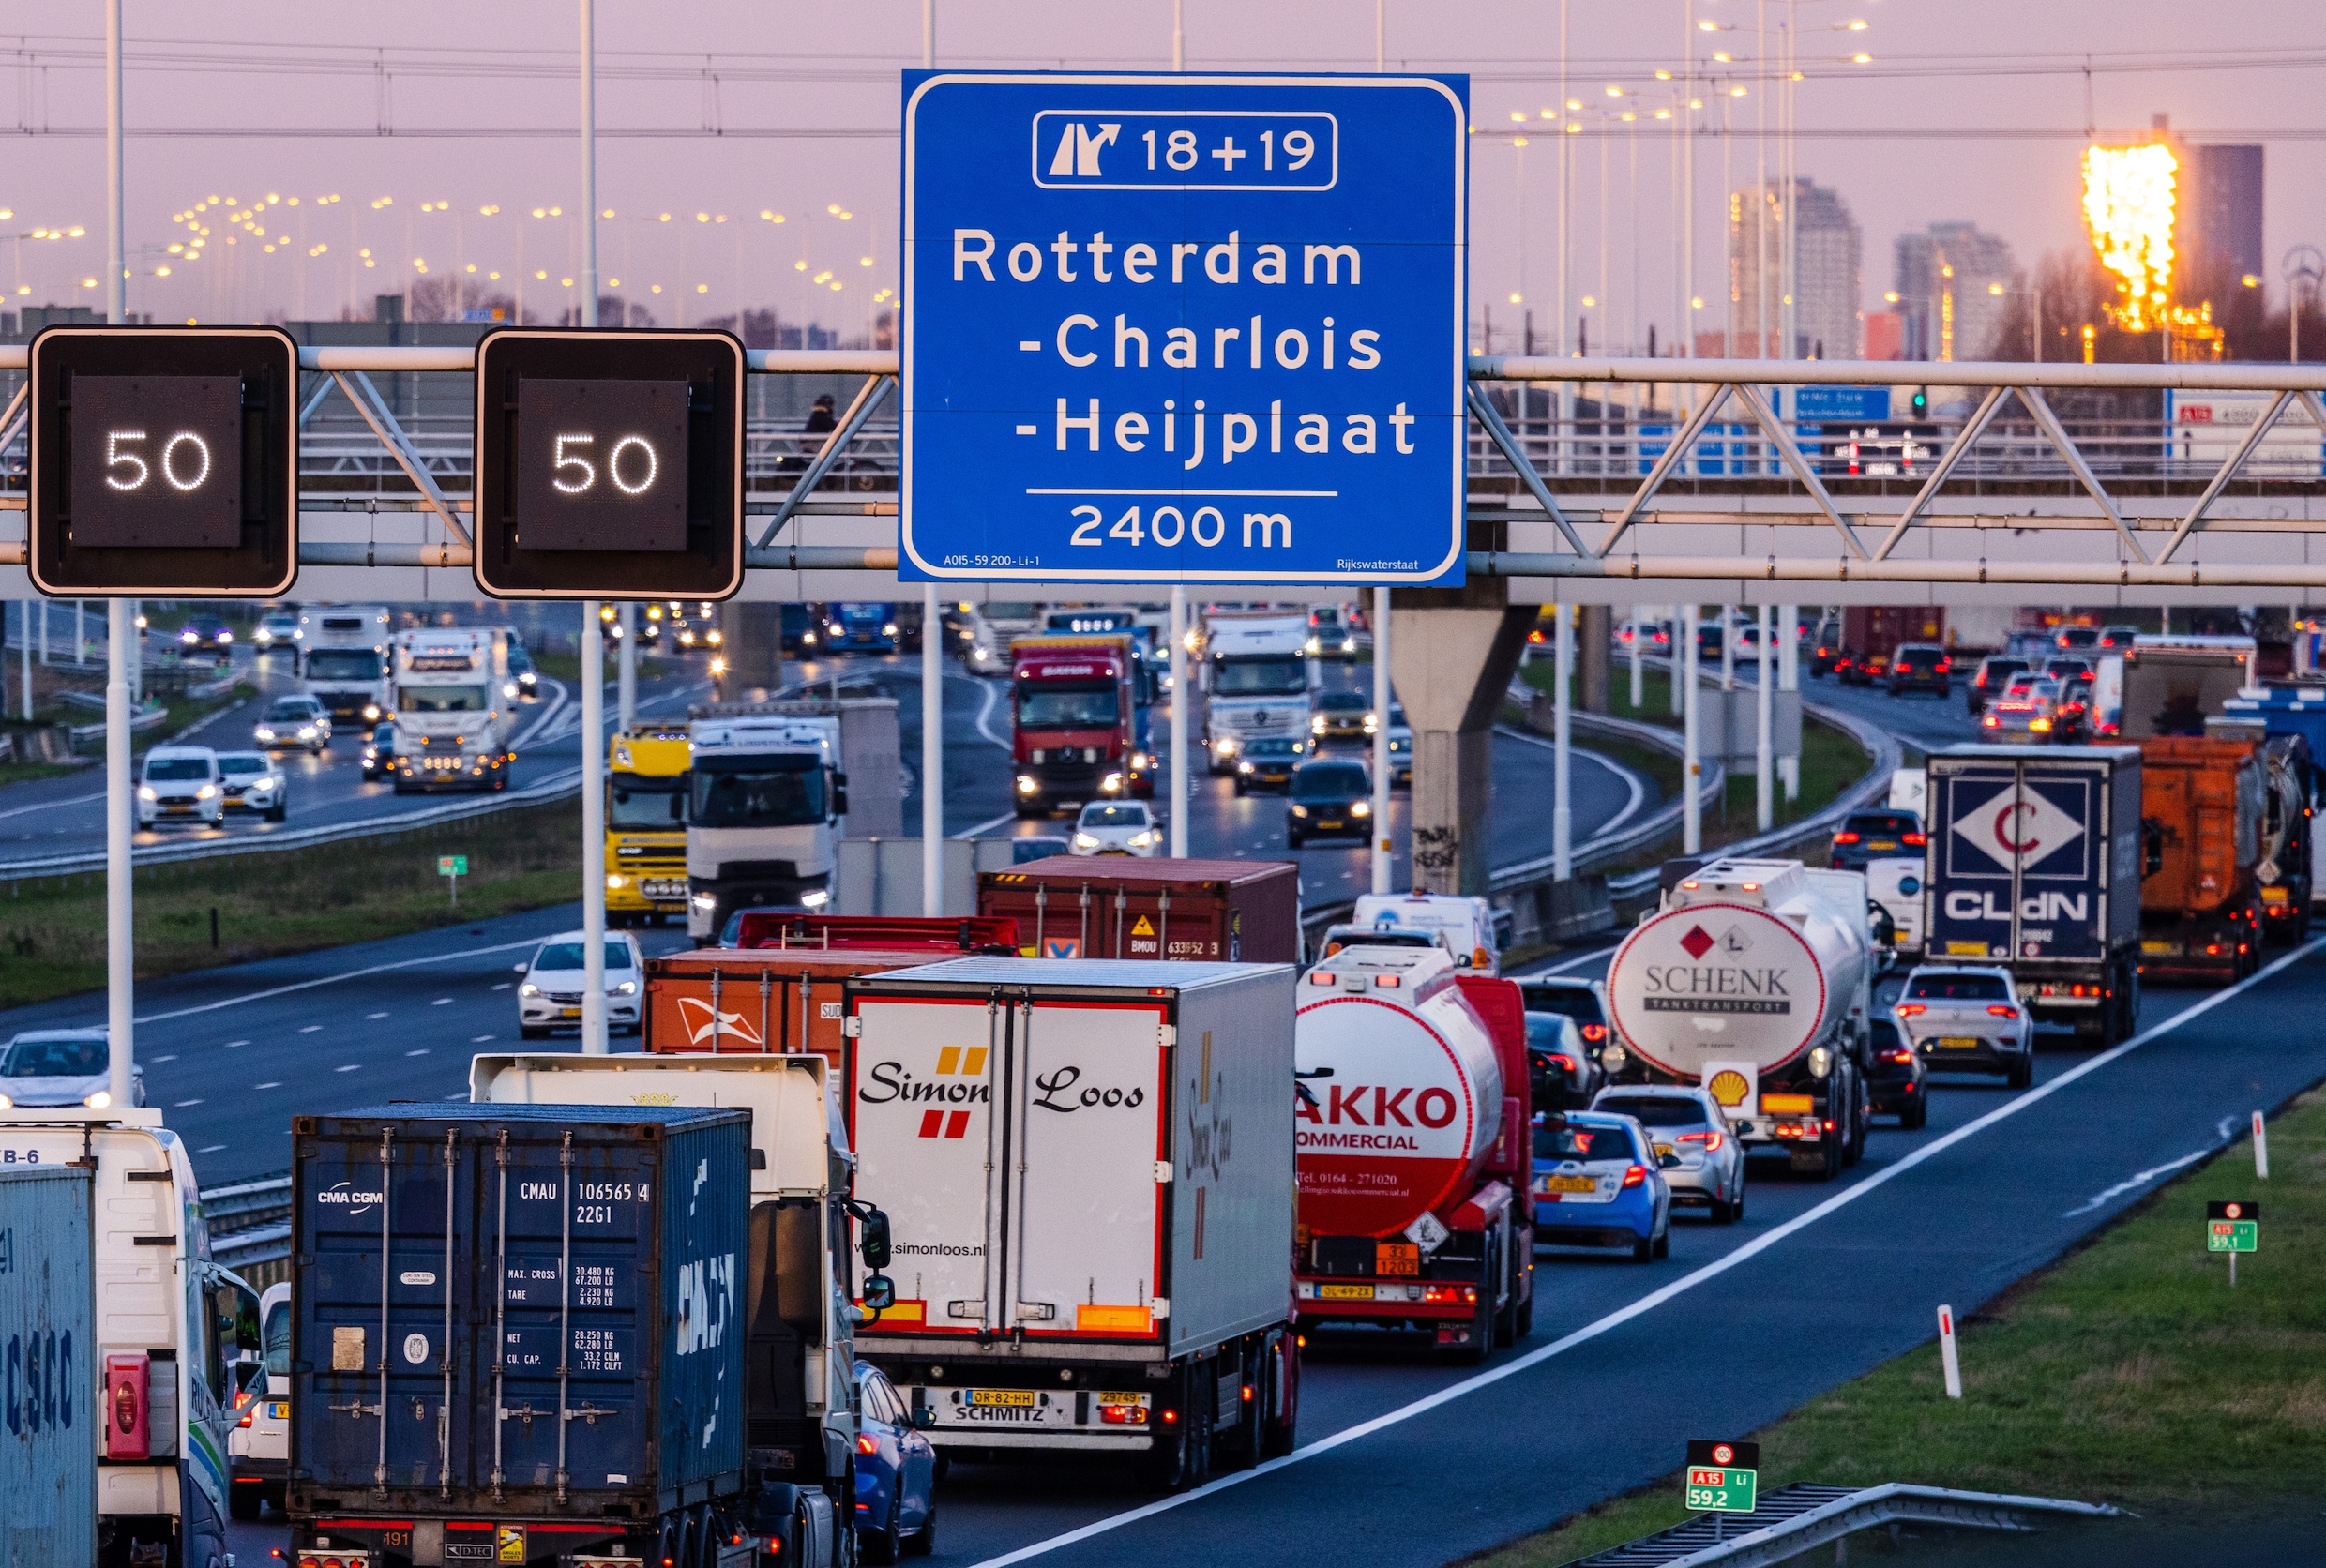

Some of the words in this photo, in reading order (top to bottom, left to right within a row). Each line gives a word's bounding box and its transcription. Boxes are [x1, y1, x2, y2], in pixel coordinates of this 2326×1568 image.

[953, 229, 1361, 285] Rotterdam
[106, 430, 211, 491] 50
[552, 433, 658, 495] 50
[1070, 505, 1225, 548] 2400
[1243, 513, 1291, 548] m
[1337, 558, 1419, 571] Rijkswaterstaat
[1994, 801, 2040, 854] C
[1944, 891, 2088, 921] CLdN
[1131, 940, 1157, 953] BMOU
[1211, 942, 1218, 955] 3
[1645, 965, 1789, 995] SCHENK
[1653, 1000, 1781, 1012] TANKTRANSPORT
[859, 1061, 989, 1104] Simon
[1032, 1065, 1144, 1113] Loos
[0, 1150, 39, 1164] B-6
[1319, 1173, 1347, 1183] 0164
[1357, 1173, 1397, 1184] 271020
[318, 1192, 349, 1203] CMA
[351, 1192, 383, 1204] CGM
[521, 1183, 556, 1199] CMAU
[579, 1184, 632, 1200] 106565
[639, 1184, 648, 1200] 4
[577, 1206, 612, 1223] 22G1
[854, 1243, 986, 1256] w.simonloos.nl
[1389, 1245, 1406, 1257] 33
[508, 1270, 526, 1278] MAX.
[575, 1267, 602, 1276] 30.480
[605, 1267, 614, 1276] KG
[1381, 1261, 1416, 1274] 1203
[575, 1276, 601, 1285] 67.200
[605, 1276, 613, 1286] LB
[508, 1290, 526, 1300] TARE
[580, 1288, 601, 1297] 2.230
[605, 1288, 614, 1297] KG
[580, 1297, 601, 1306] 4.920
[605, 1297, 613, 1306] LB
[507, 1334, 521, 1343] NET
[575, 1331, 601, 1340] 28.250
[605, 1332, 613, 1340] KG
[575, 1340, 601, 1349] 62.280
[605, 1340, 613, 1349] LB
[507, 1354, 520, 1364] CU.
[524, 1355, 541, 1364] CAP.
[584, 1352, 601, 1361] 33.2
[580, 1362, 600, 1370] 1.172
[1102, 1392, 1137, 1403] 29749
[956, 1407, 1044, 1422] SCHMITZ
[1717, 1450, 1729, 1459] 100
[1736, 1474, 1746, 1485] Li
[1689, 1489, 1728, 1508] 59,2
[385, 1532, 409, 1546] 191
[462, 1547, 490, 1556] D-TEC
